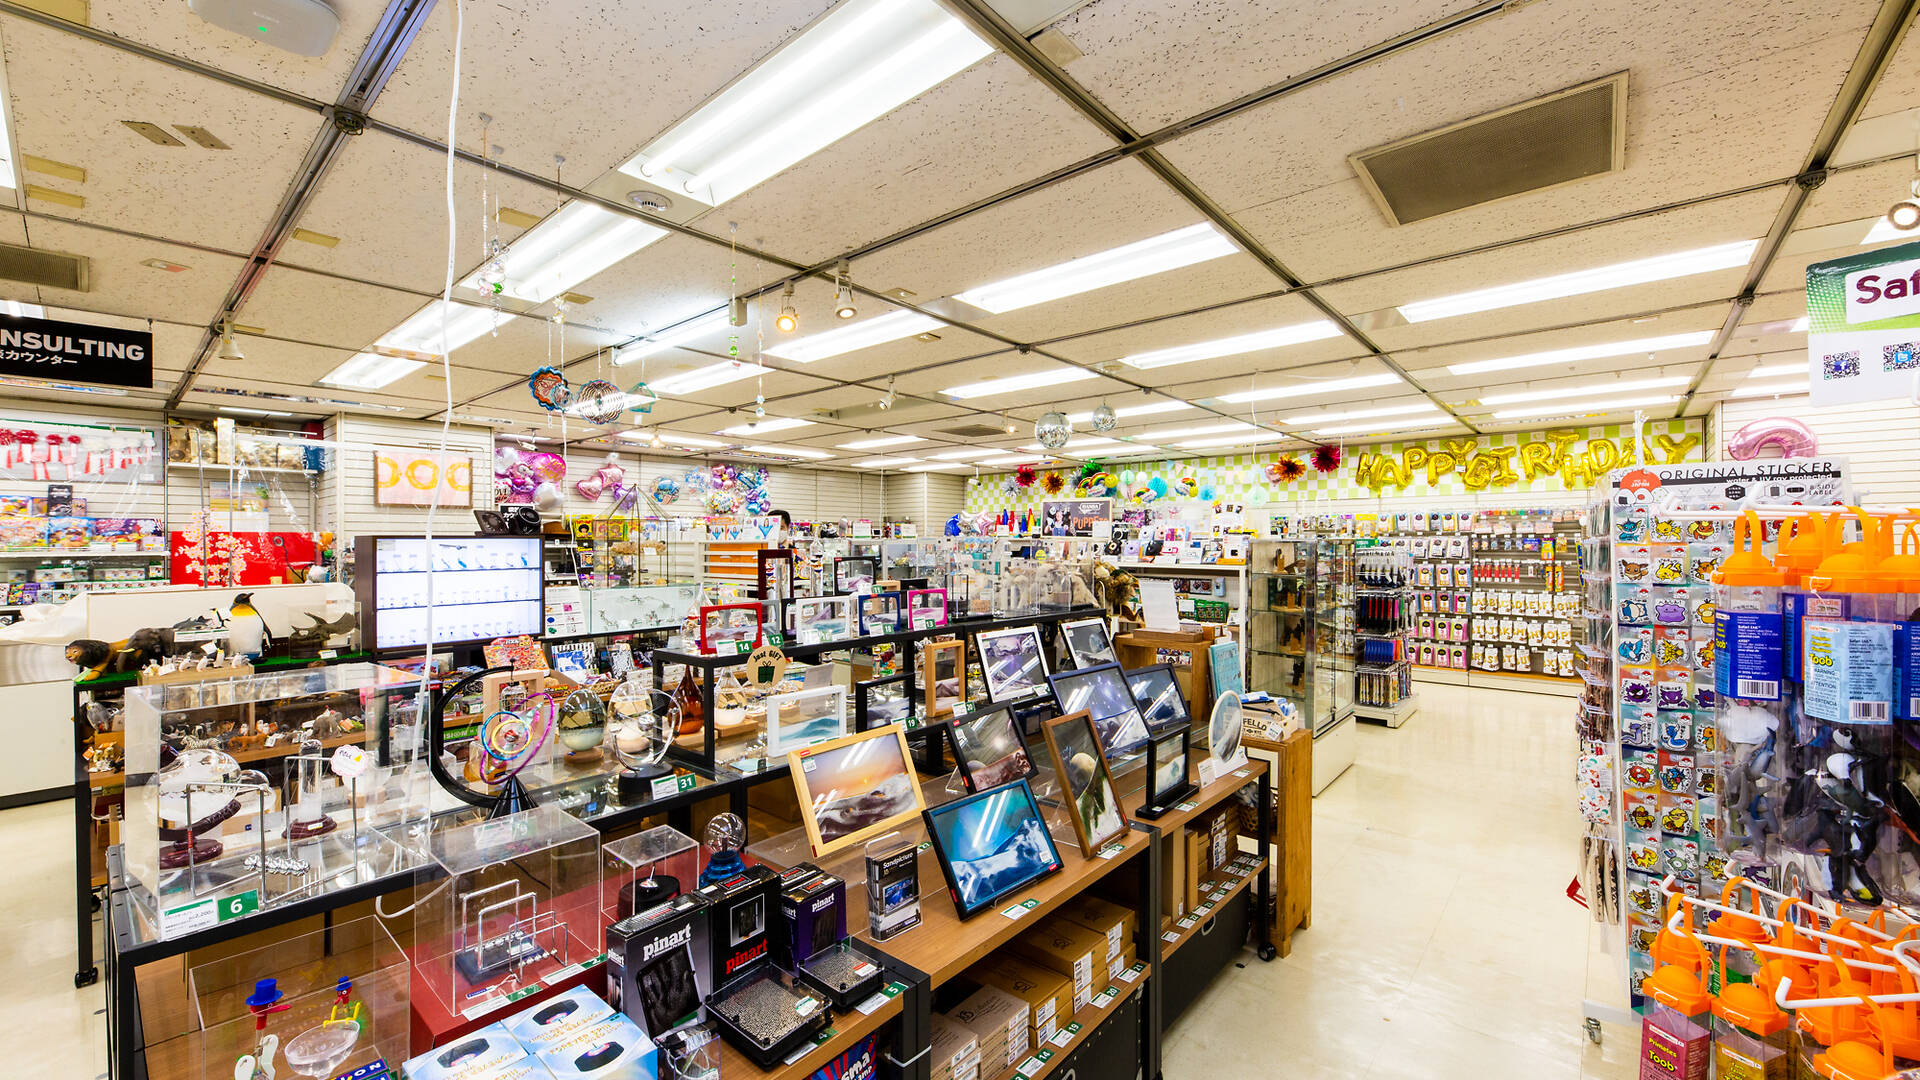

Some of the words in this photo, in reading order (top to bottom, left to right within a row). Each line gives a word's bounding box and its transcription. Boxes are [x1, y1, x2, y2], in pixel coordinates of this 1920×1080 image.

[0, 328, 145, 361] NSULTING
[1356, 440, 1478, 490] HAPPY
[1660, 466, 1746, 480] ORIGINAL
[1757, 461, 1832, 475] STICKER
[1789, 473, 1832, 482] protected
[772, 636, 781, 644] 12
[740, 643, 749, 651] 14
[1809, 654, 1833, 666] Toob
[908, 719, 915, 728] 19
[680, 777, 693, 789] 31
[230, 899, 243, 913] 6
[811, 893, 835, 912] pinart
[1023, 900, 1037, 909] 29
[643, 923, 691, 961] pinart
[607, 947, 624, 965] pinart
[725, 938, 767, 975] pinart
[1068, 1023, 1080, 1032] 19
[1039, 1051, 1051, 1060] 14
[1648, 1050, 1675, 1072] Toob
